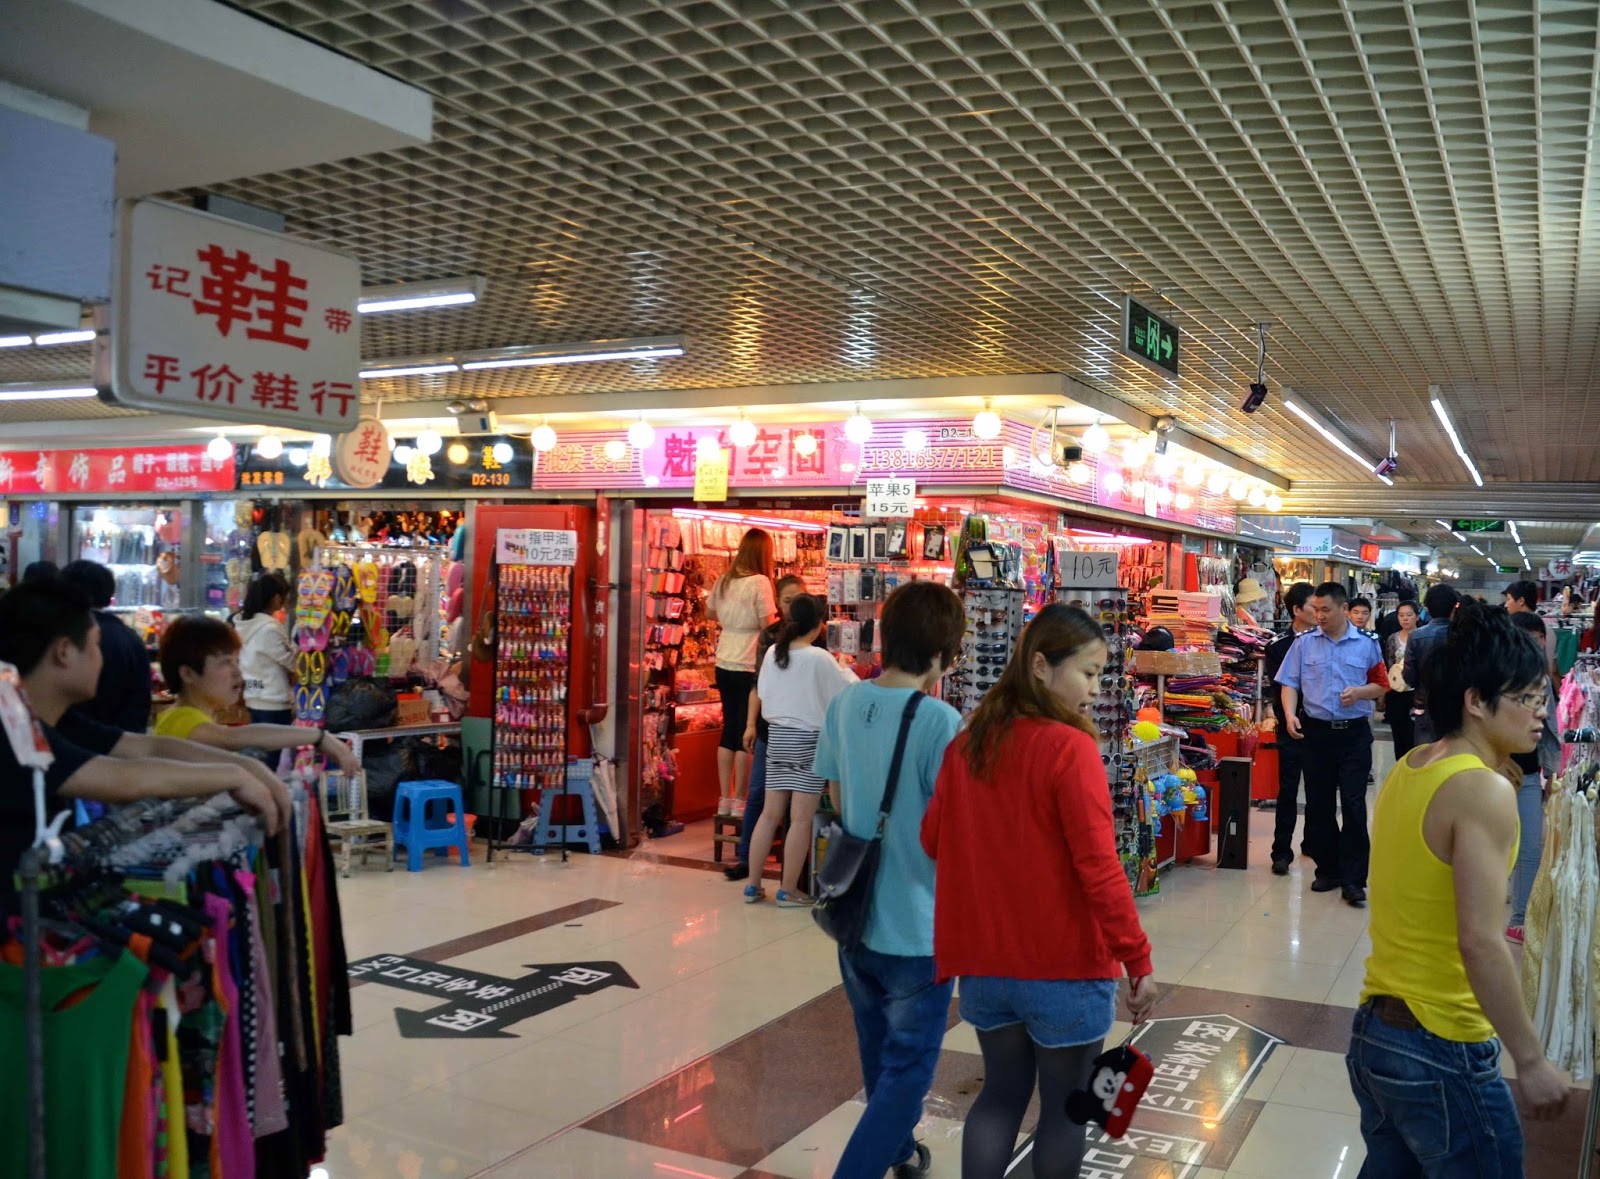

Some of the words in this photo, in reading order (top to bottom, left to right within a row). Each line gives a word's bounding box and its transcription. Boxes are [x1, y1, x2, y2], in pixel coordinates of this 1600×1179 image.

[144, 354, 356, 417] 平价鞋行
[353, 425, 382, 464] 鞋
[871, 447, 996, 468] 13816577121
[471, 473, 510, 486] D2-130
[869, 483, 911, 497] 苹果5
[871, 502, 909, 513] 15元
[529, 531, 569, 545] 指甲油
[526, 547, 576, 561] 10元2瓶
[1073, 555, 1114, 580] 10元
[347, 956, 405, 977] EXIT
[380, 965, 514, 1000] 安全出口
[1147, 1040, 1221, 1092] 安全出口
[1139, 1091, 1204, 1111] XIT
